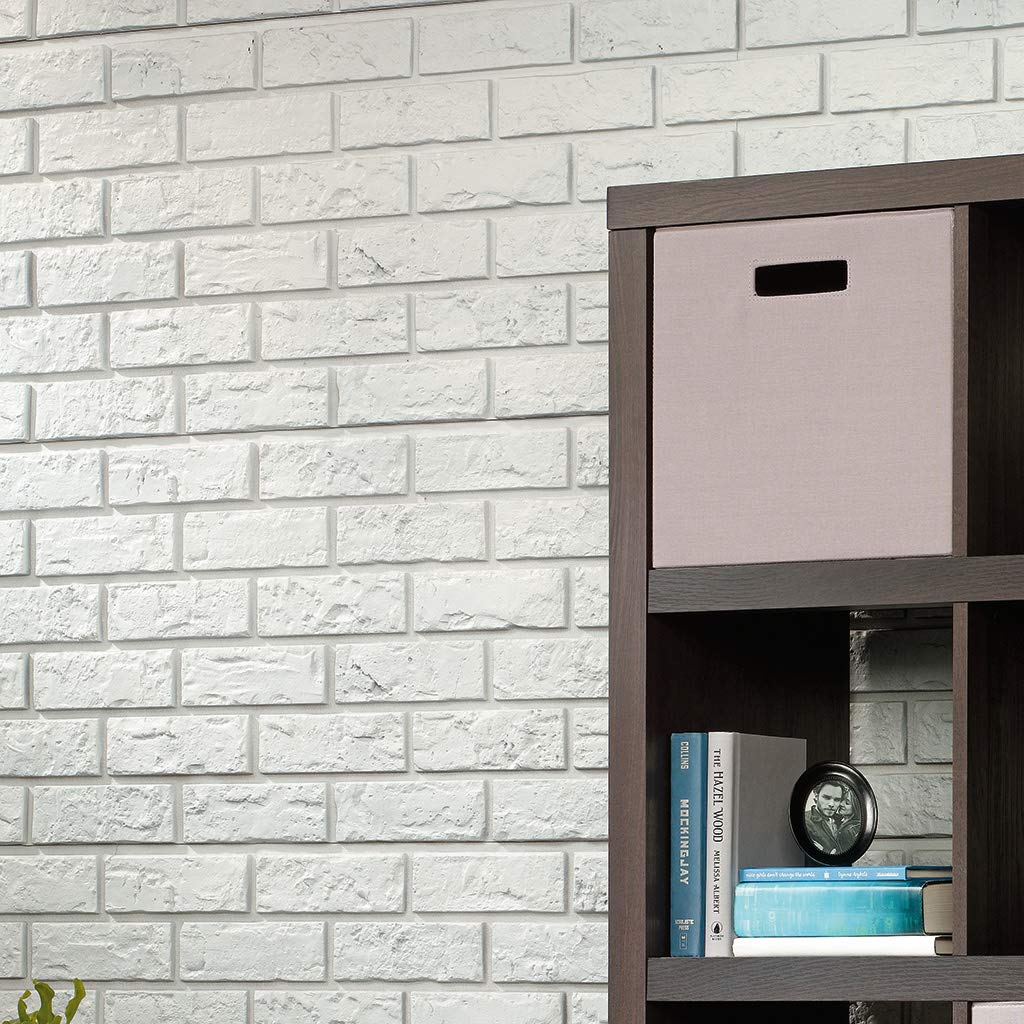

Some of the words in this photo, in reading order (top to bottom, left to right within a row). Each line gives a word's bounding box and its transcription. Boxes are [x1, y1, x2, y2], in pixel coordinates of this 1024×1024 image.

[681, 741, 689, 769] COLLINS
[713, 749, 721, 767] THE
[713, 771, 723, 806] HAZEL
[680, 799, 689, 885] MOCKINGJAY
[713, 807, 723, 843] WOOD
